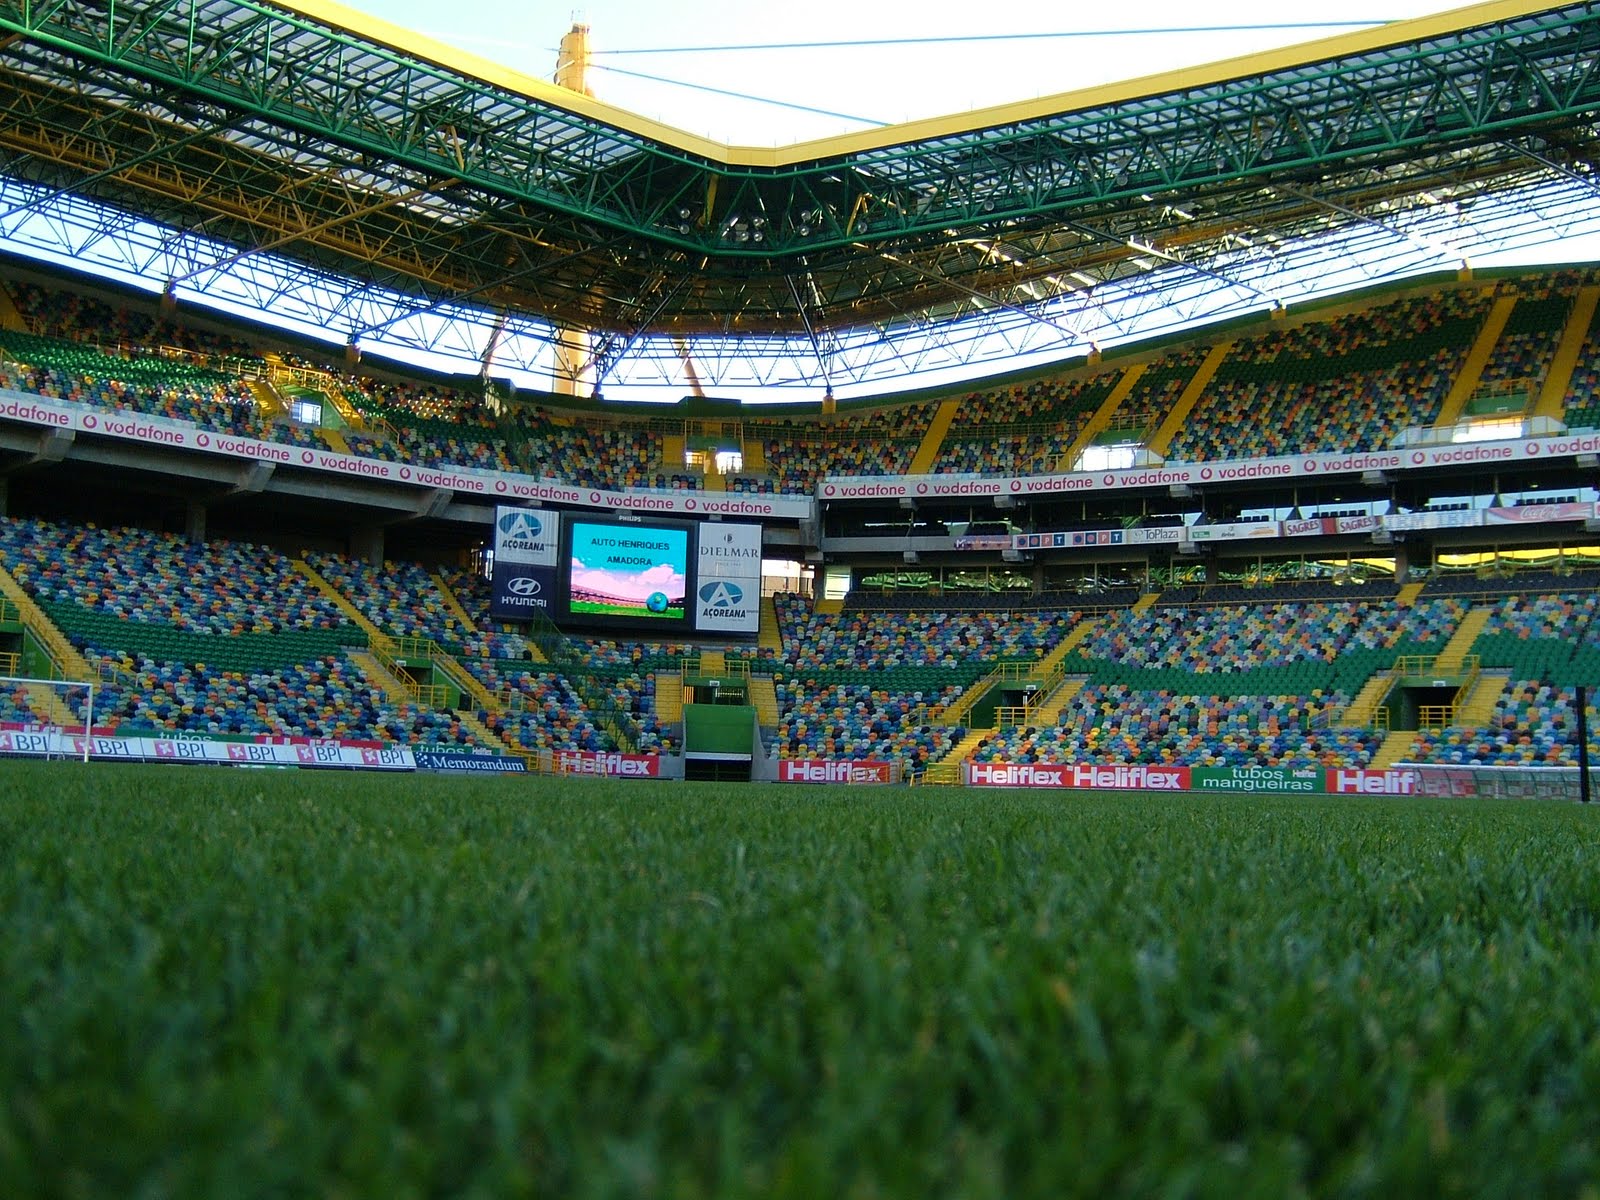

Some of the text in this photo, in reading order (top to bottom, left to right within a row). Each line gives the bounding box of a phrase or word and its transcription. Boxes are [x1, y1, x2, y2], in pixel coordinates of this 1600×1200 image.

[104, 421, 184, 444] vodafone
[216, 438, 290, 461] vodafone
[1547, 437, 1600, 454] vodaf
[1432, 445, 1512, 463] vodafone
[320, 458, 389, 477] vodafone
[1218, 462, 1291, 478] vodafone
[1323, 455, 1399, 471] vodafone
[416, 472, 484, 491] vodafone
[1026, 477, 1093, 492] vodafone
[1120, 470, 1190, 486] vodafone
[512, 484, 580, 502] vodafone
[840, 483, 906, 497] vodafone
[934, 482, 1000, 495] vodafone
[606, 495, 674, 510] vodafone
[702, 501, 772, 515] vodafone
[1287, 520, 1319, 535] SAGRES
[1340, 517, 1373, 533] SAGRES
[502, 539, 545, 551] AÇOREANA
[591, 538, 670, 551] AUTO HENRIQUES
[700, 546, 759, 558] DIELMAR
[606, 556, 653, 566] AMADORA
[501, 596, 547, 608] HYUNDAI
[702, 608, 746, 619] AÇOREANA
[15, 734, 49, 751] BPI
[97, 740, 131, 755] BPI
[176, 742, 207, 758] BPI
[420, 744, 465, 754] tubos
[248, 745, 277, 761] BPI
[316, 747, 342, 762] BPI
[380, 750, 406, 764] BPI
[432, 755, 525, 771] Memorandum
[560, 752, 650, 775] Heliflex
[787, 761, 880, 781] Heliflex
[971, 765, 1062, 785] Heliflex
[1073, 766, 1180, 788] Heliflex
[1232, 767, 1283, 779] tubos
[1203, 777, 1313, 791] mangueiras
[1337, 770, 1415, 794] Helif
